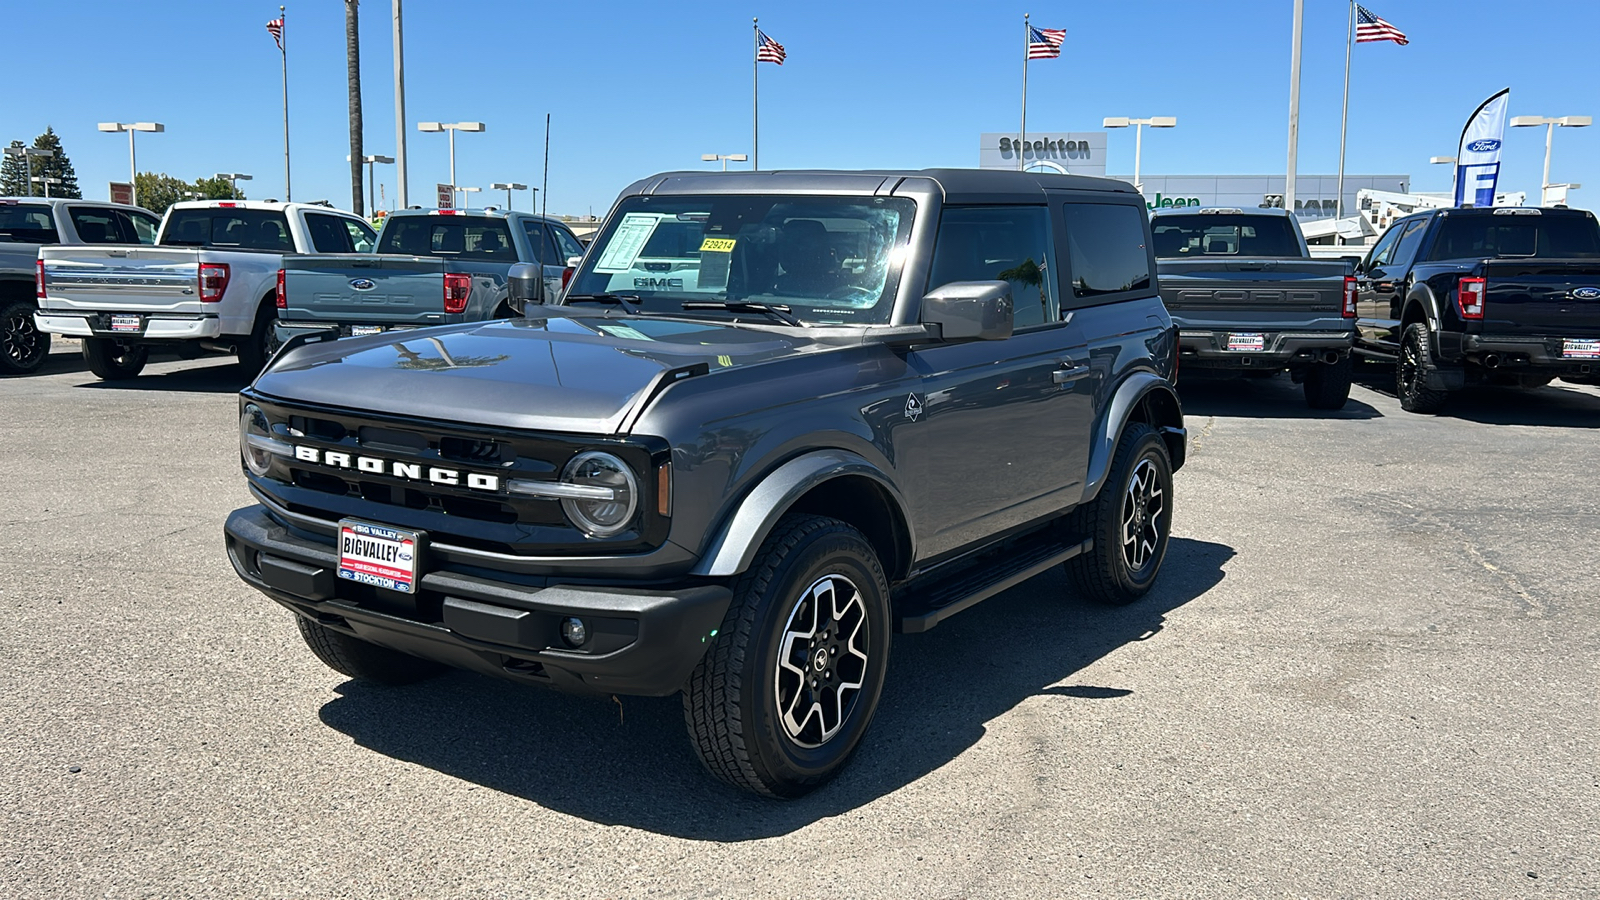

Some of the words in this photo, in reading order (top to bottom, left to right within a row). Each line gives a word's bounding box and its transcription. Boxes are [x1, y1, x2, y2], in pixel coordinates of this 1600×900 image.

[999, 137, 1089, 152] Stockton
[1472, 140, 1498, 151] Ford
[1147, 193, 1200, 208] Jeep
[703, 240, 734, 250] F29214
[633, 277, 684, 288] GMC
[312, 292, 415, 306] F-150
[1177, 290, 1322, 302] FORD
[295, 445, 500, 491] BRONCO
[357, 525, 369, 533] BIG
[371, 527, 397, 538] VALLEY
[344, 537, 399, 562] BIGVALLEY
[353, 571, 395, 588] STOCKTON
